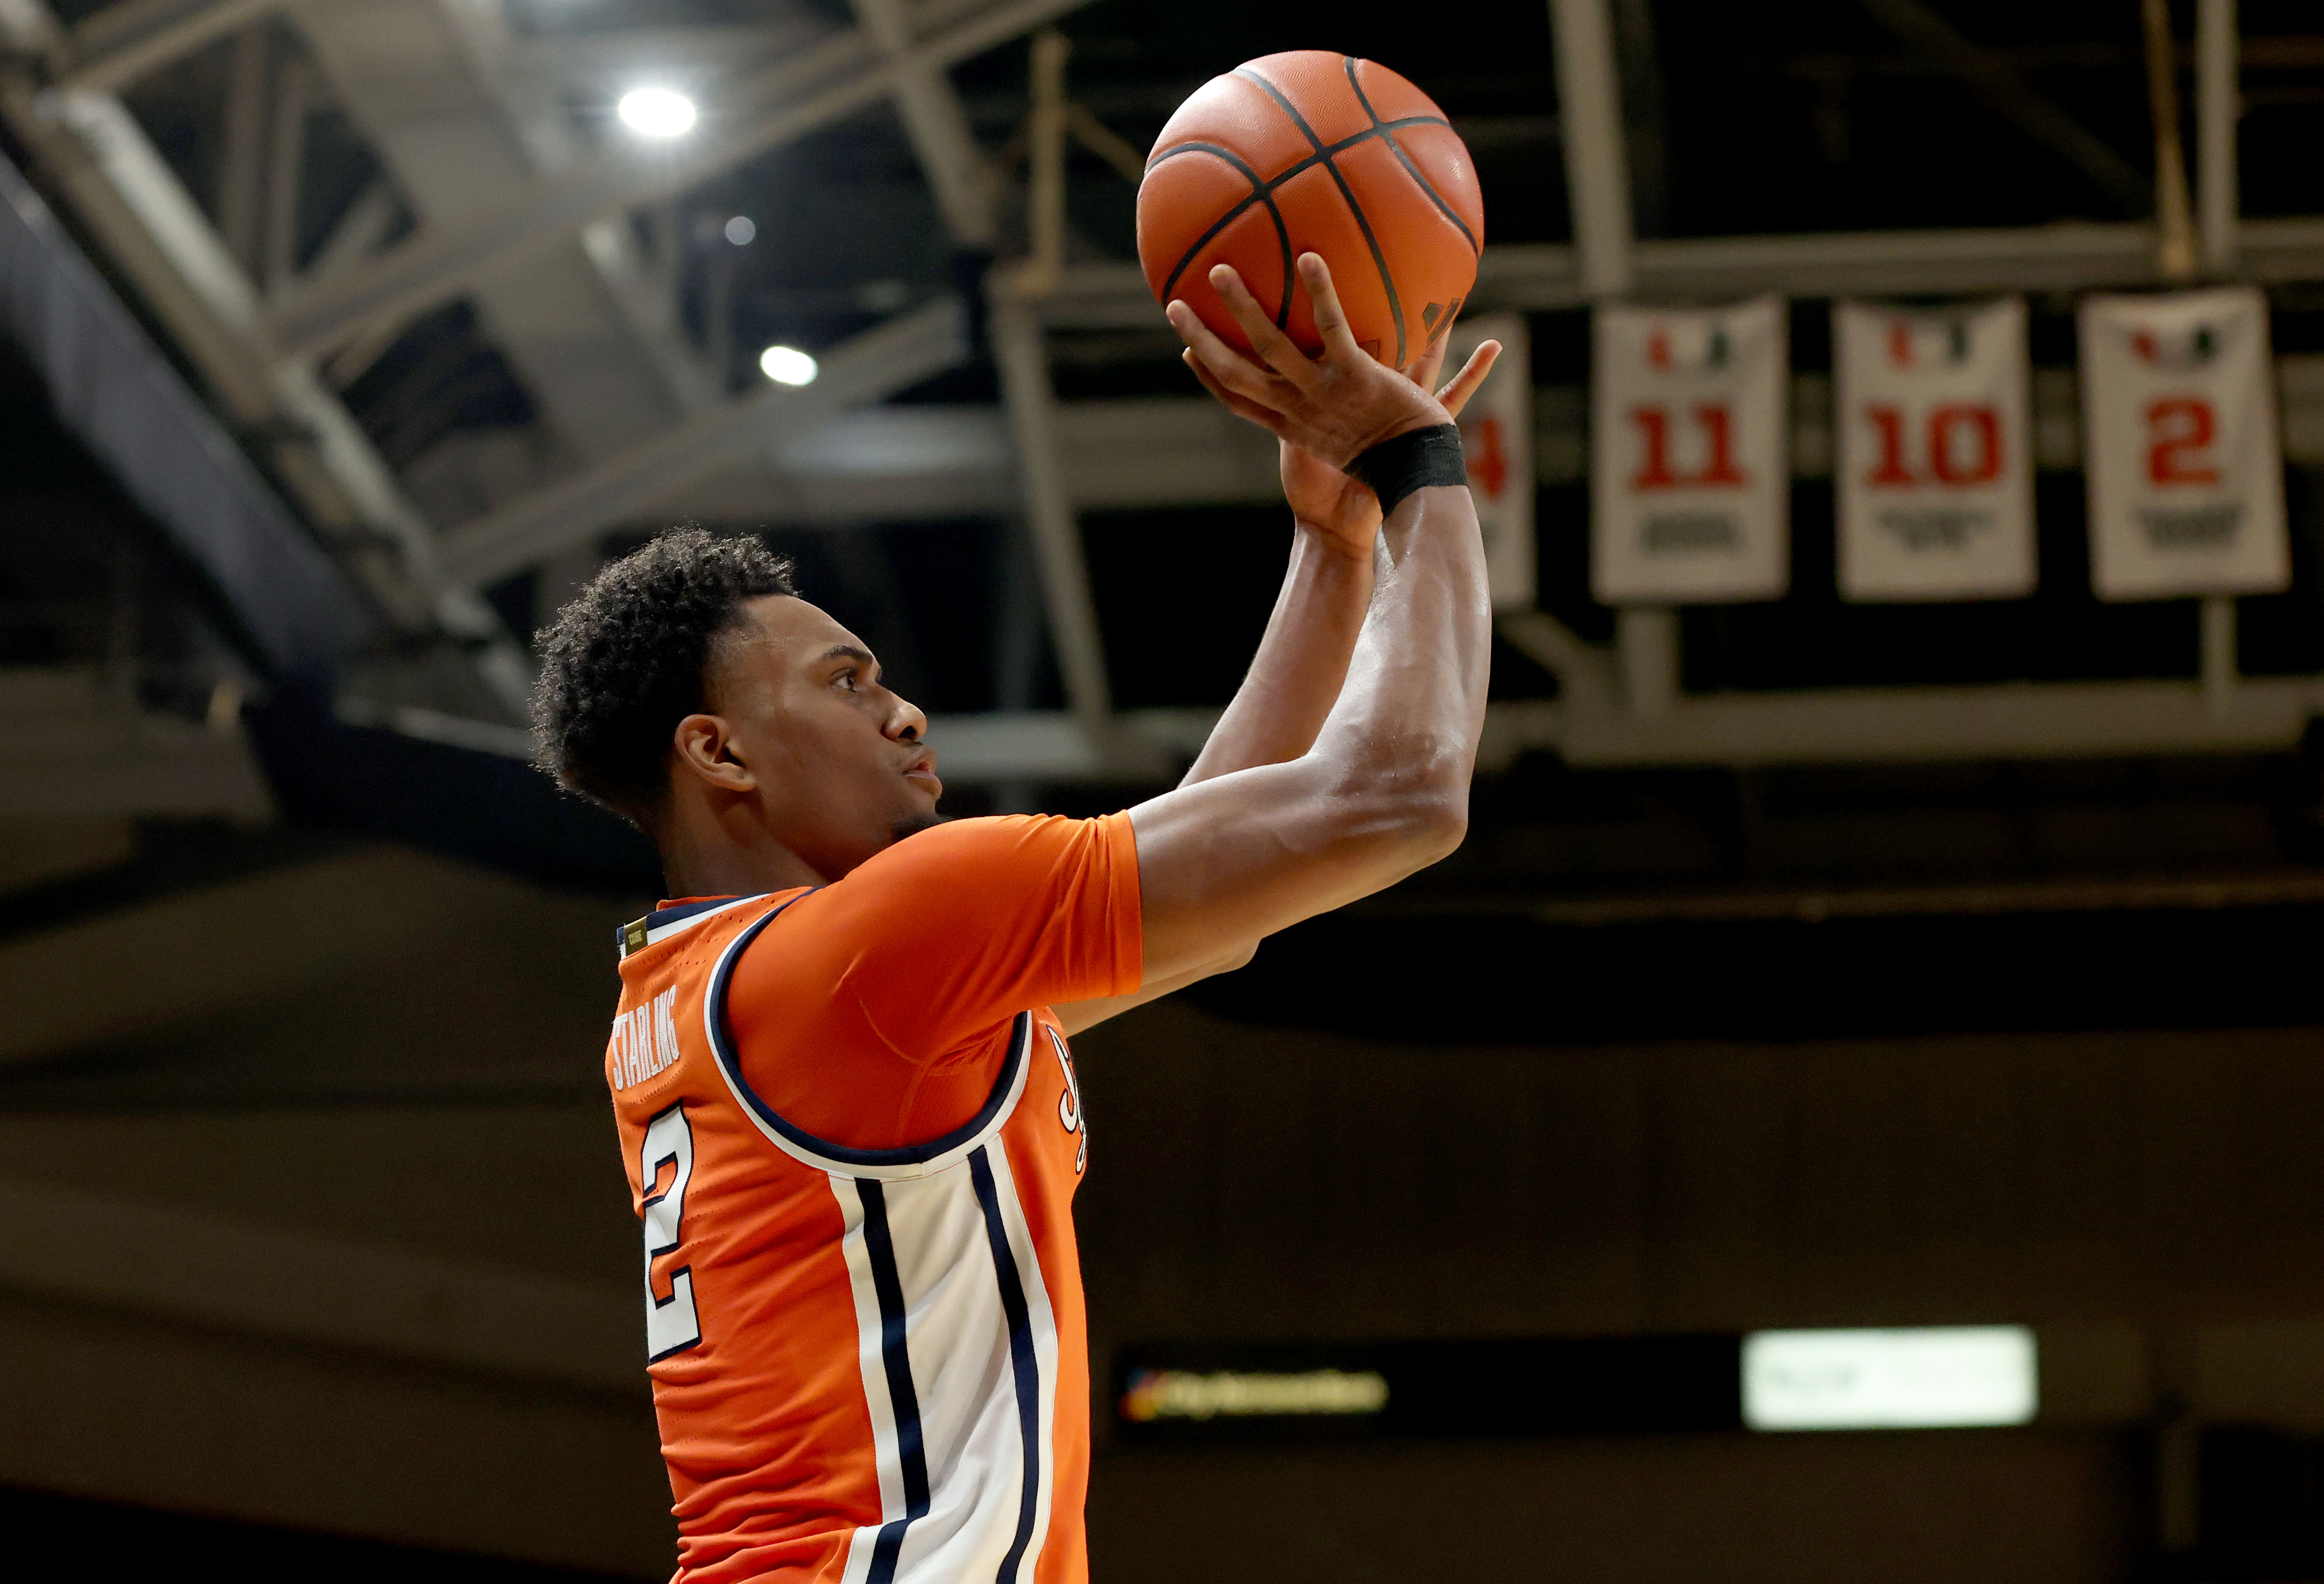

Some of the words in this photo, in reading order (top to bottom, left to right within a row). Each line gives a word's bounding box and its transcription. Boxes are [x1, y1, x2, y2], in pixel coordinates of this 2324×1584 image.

[1626, 400, 1754, 497] 11
[1862, 399, 2011, 495] 10
[2140, 393, 2222, 491] 2
[611, 984, 680, 1091] STARLING
[641, 1097, 703, 1366] 2
